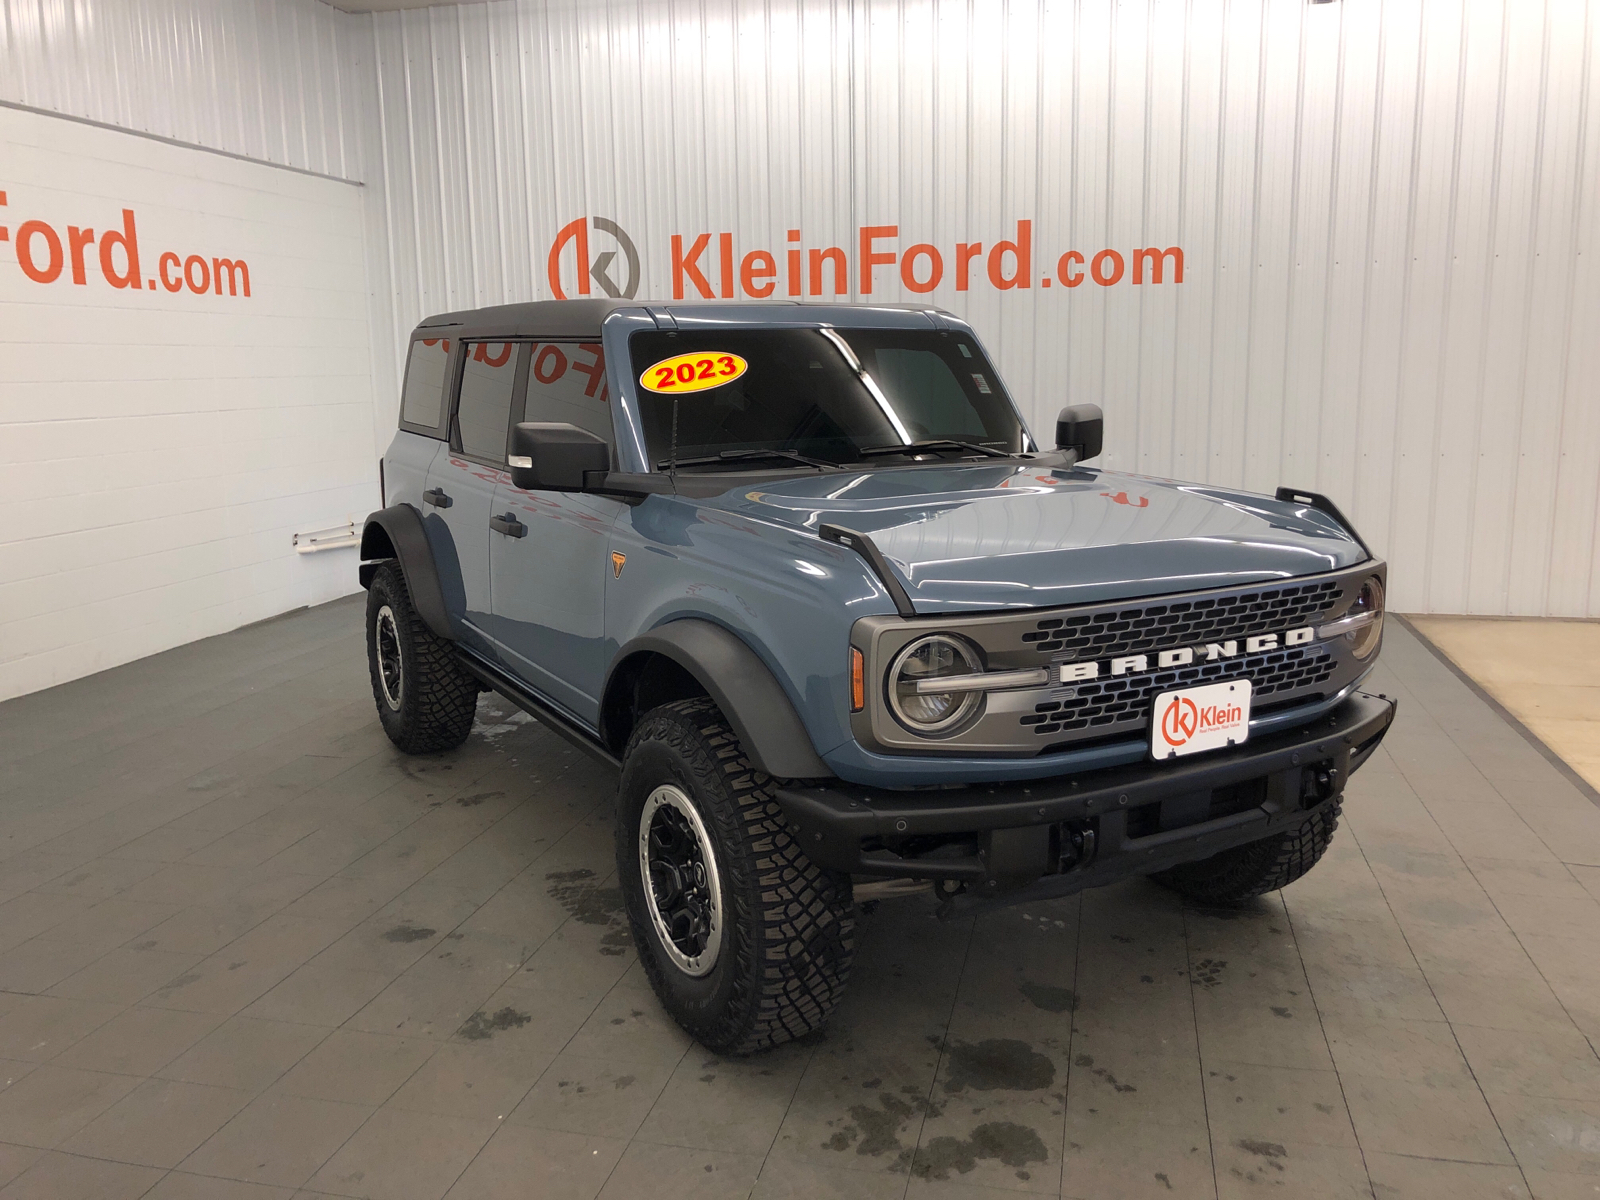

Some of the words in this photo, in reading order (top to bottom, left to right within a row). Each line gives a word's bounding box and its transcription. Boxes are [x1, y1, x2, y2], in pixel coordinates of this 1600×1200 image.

[0, 190, 251, 298] ord.com
[671, 219, 1184, 300] KleinFord.com
[655, 356, 737, 389] 2023
[1060, 626, 1314, 683] BRONCO
[1200, 702, 1242, 728] Klein
